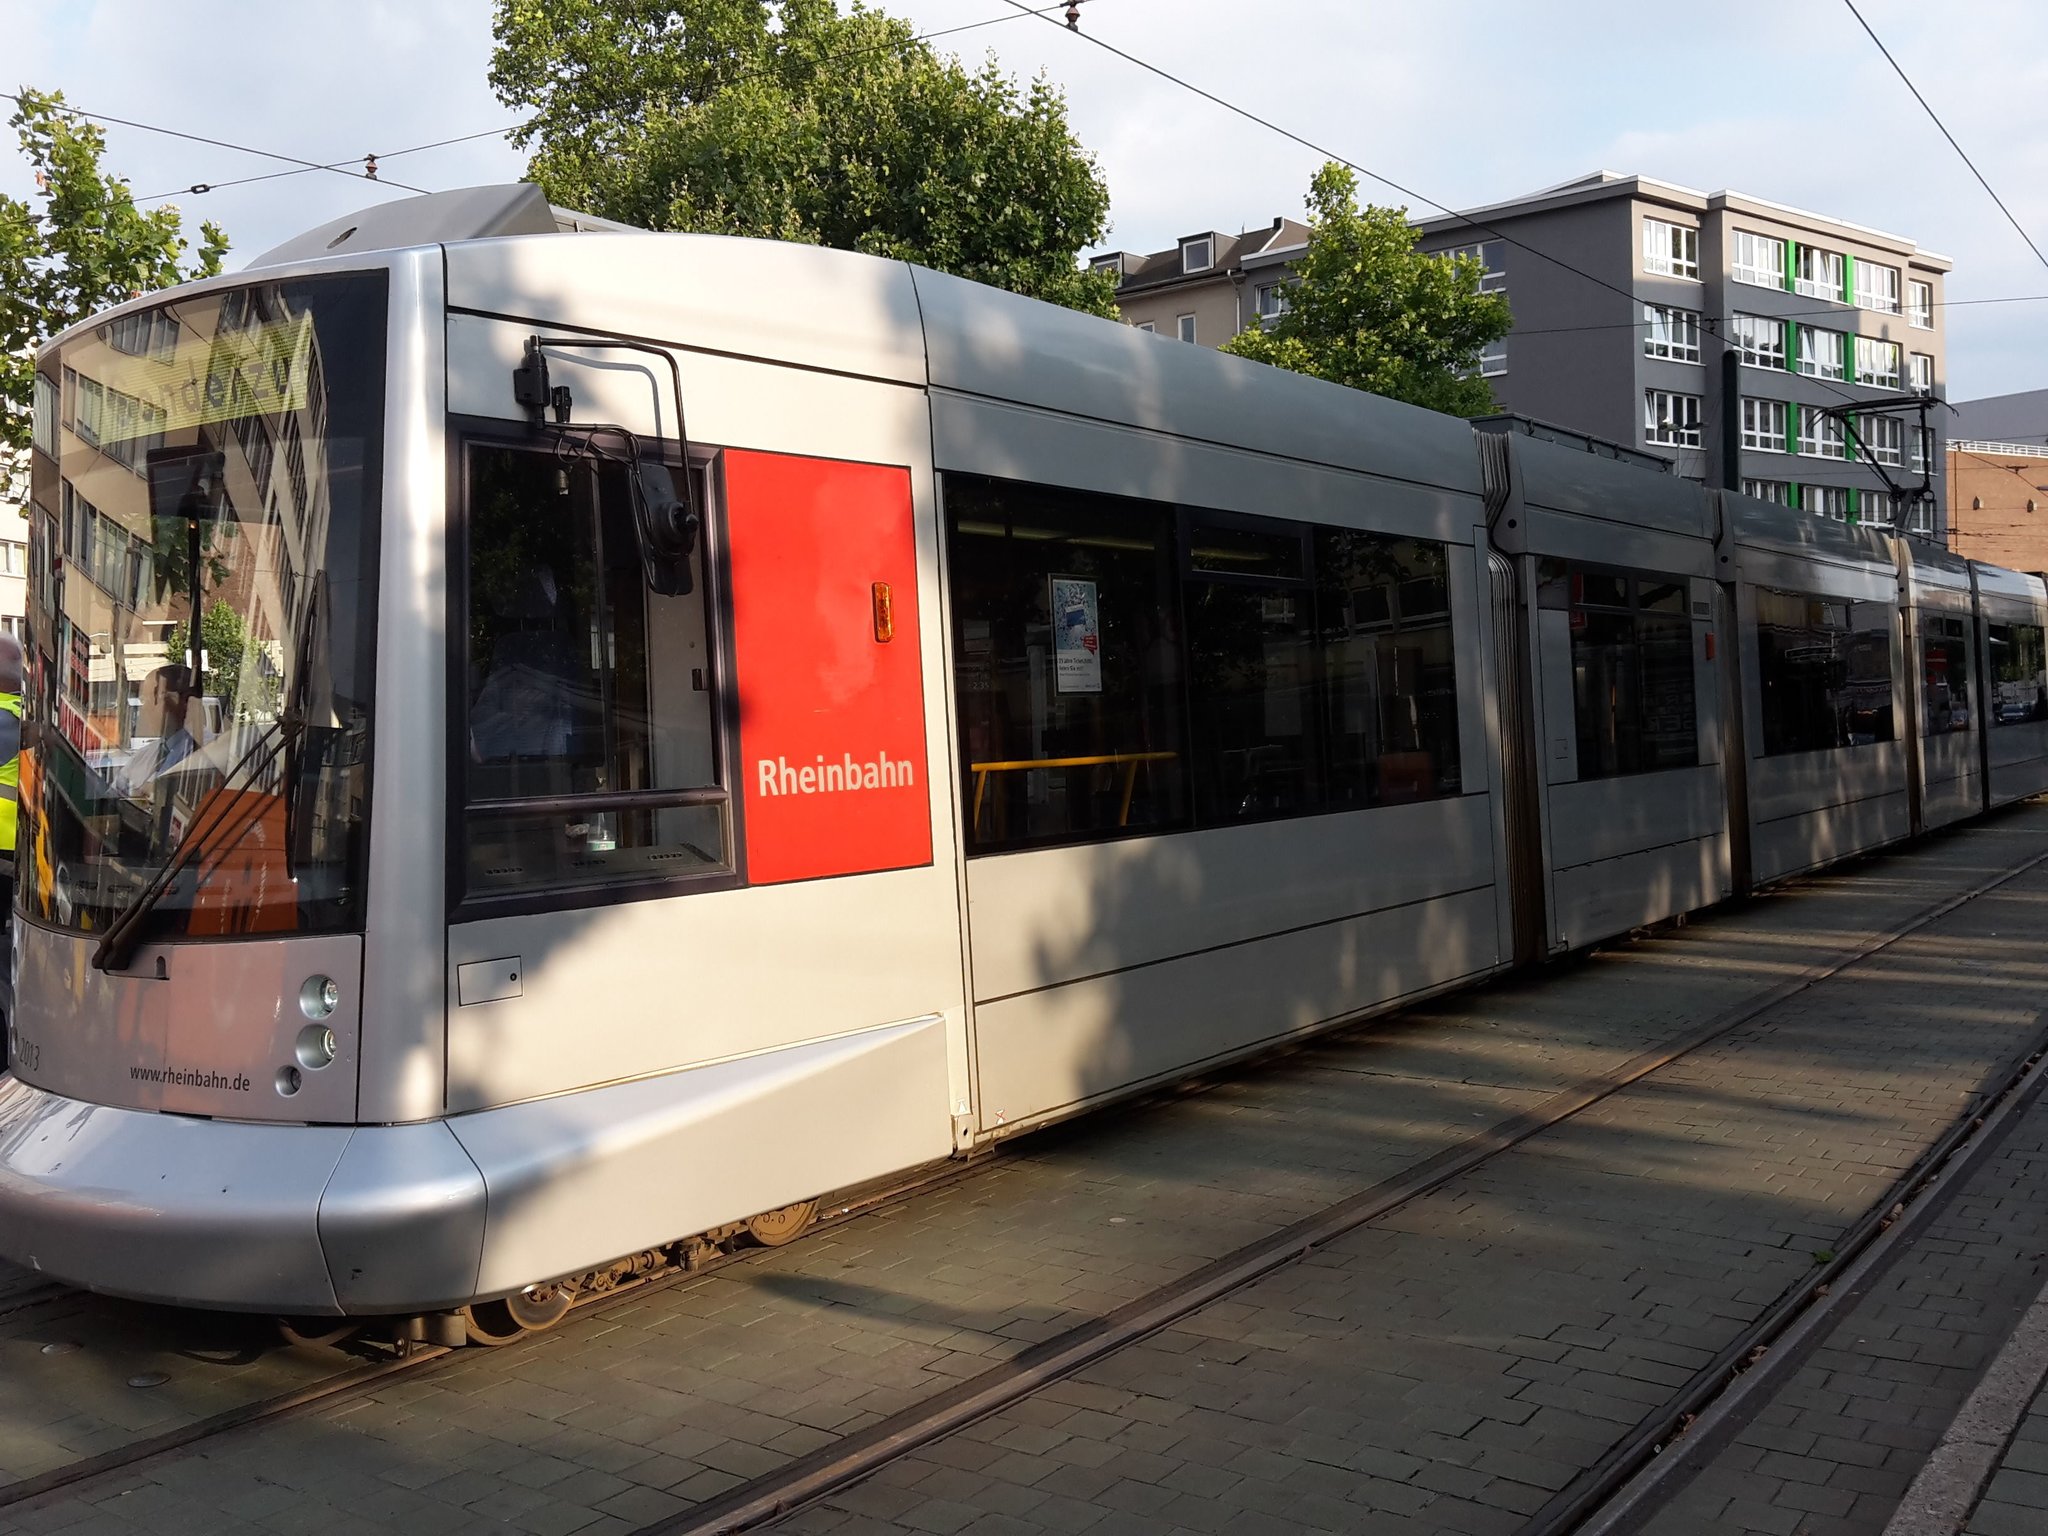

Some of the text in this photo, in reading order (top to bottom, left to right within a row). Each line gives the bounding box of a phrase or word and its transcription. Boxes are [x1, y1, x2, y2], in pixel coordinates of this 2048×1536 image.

[758, 751, 913, 797] Rheinbahn
[19, 1037, 40, 1072] 2013
[130, 1066, 250, 1092] www.rheinbahn.de
